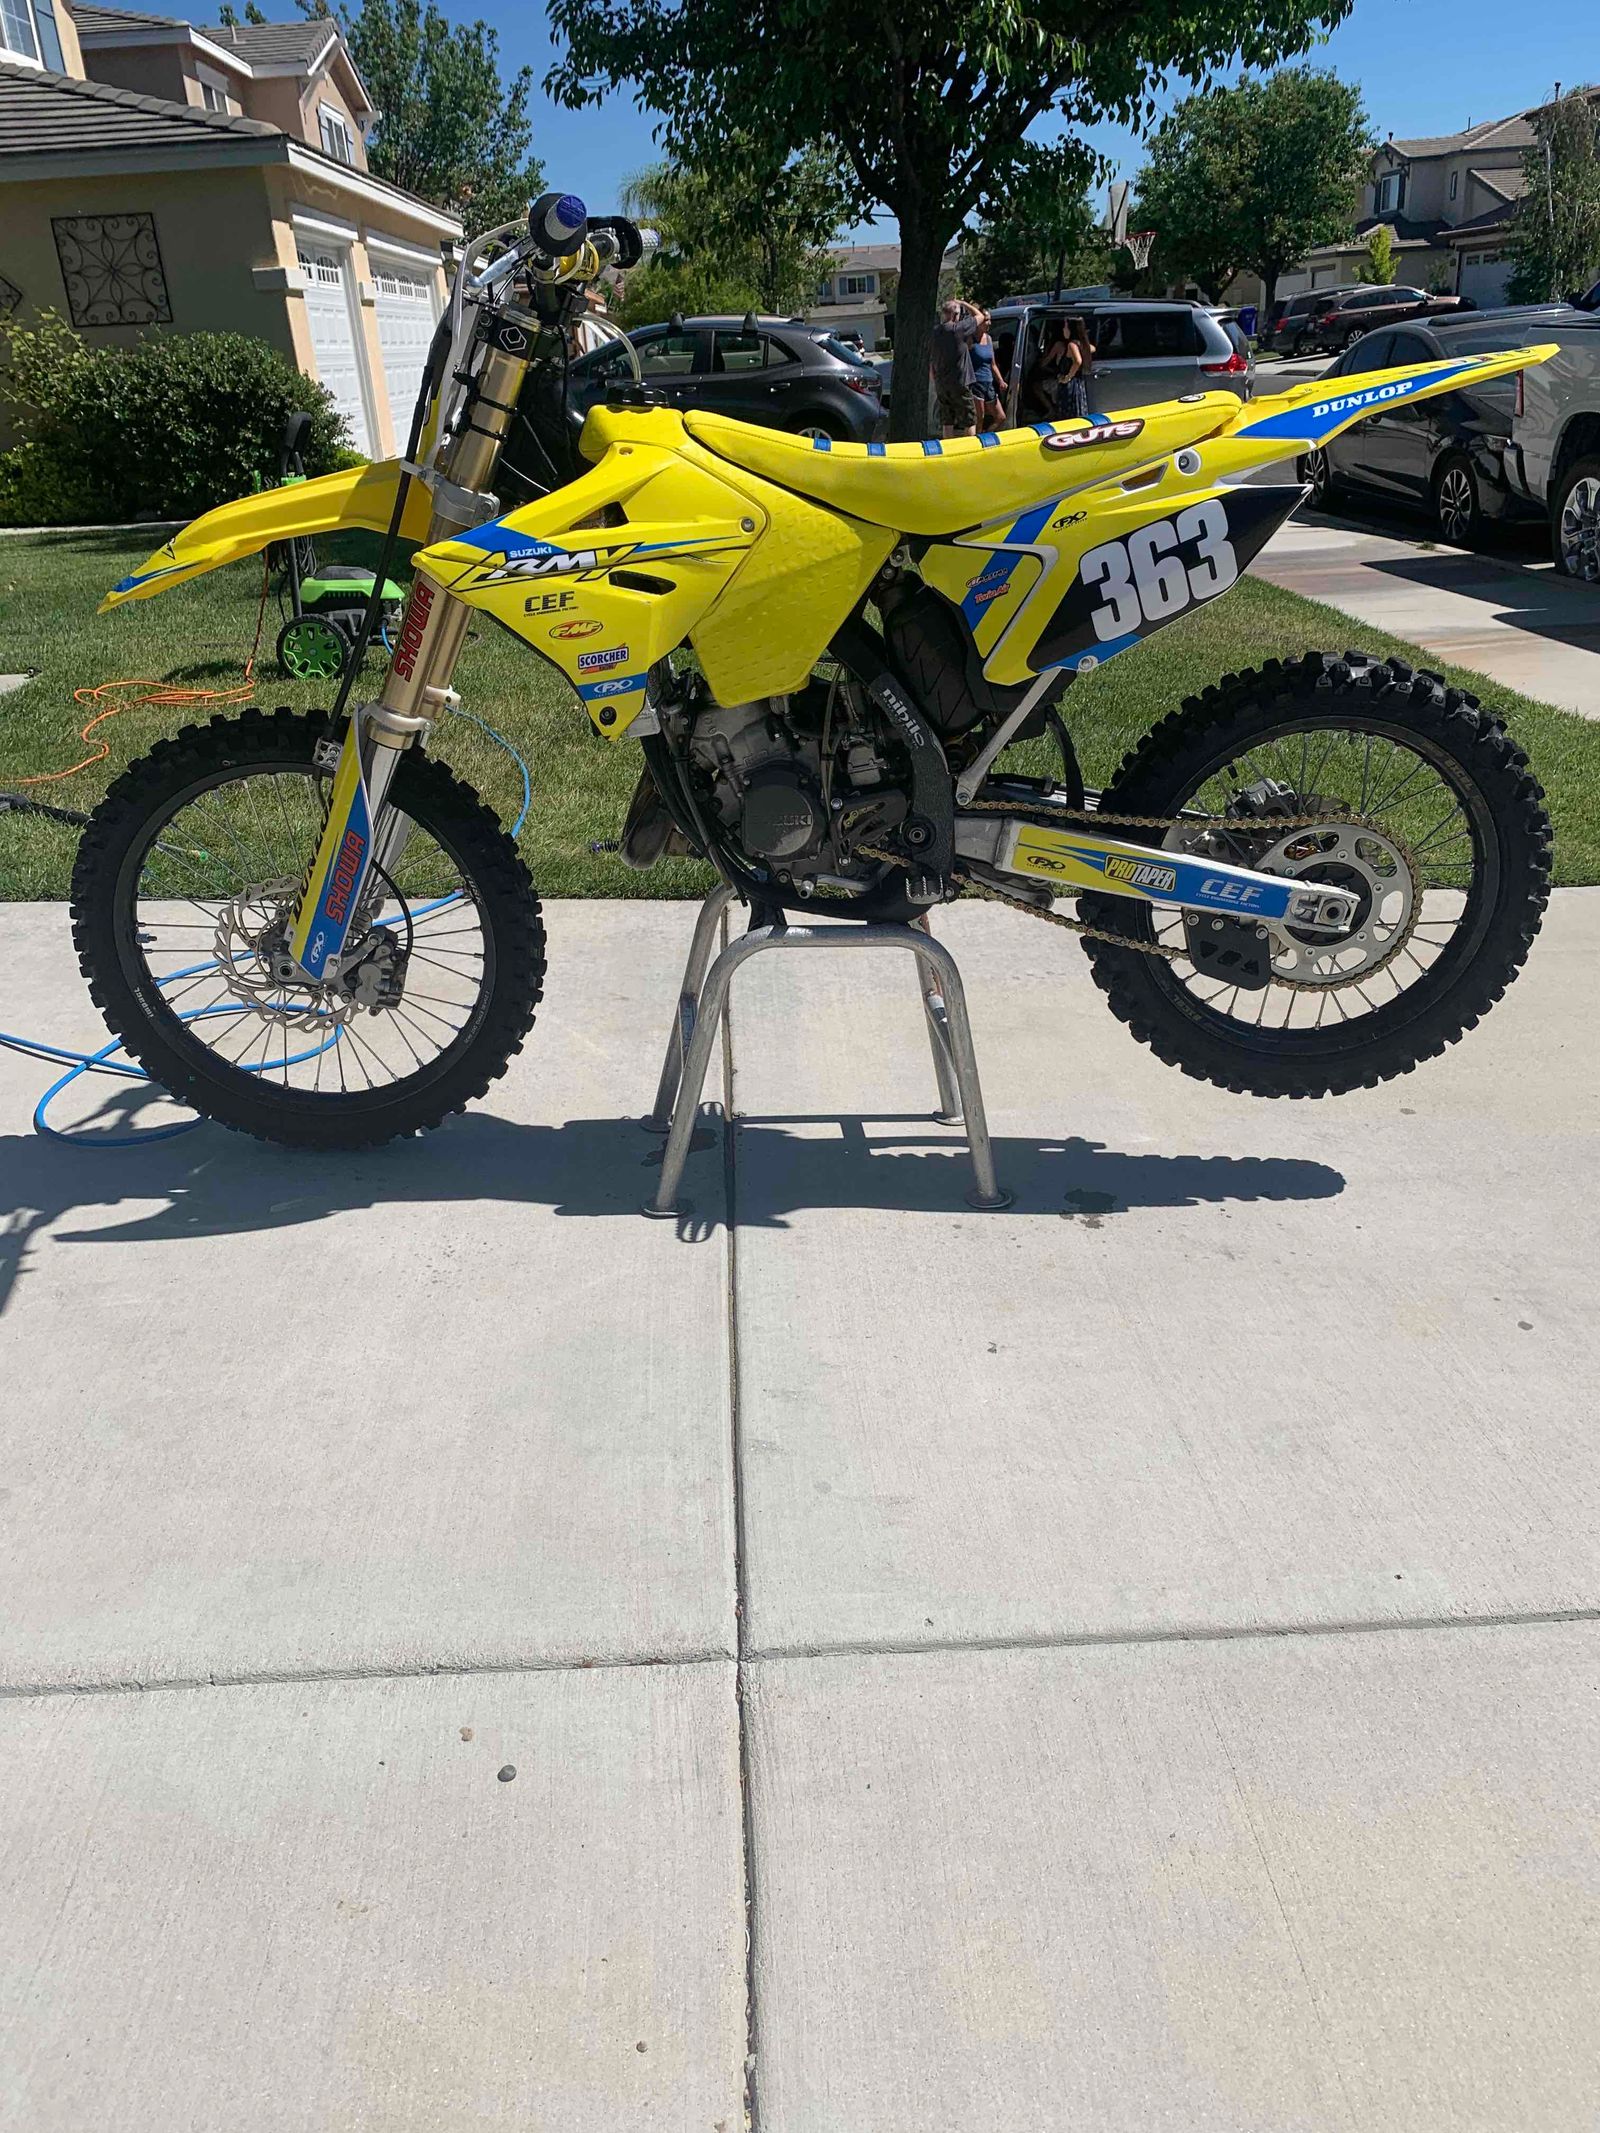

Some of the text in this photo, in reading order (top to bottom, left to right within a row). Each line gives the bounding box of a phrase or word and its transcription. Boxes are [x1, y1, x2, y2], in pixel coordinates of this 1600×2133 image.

[1312, 381, 1413, 418] DUNLOP
[1048, 419, 1140, 447] GUTS
[509, 546, 553, 558] SUZUKI
[1080, 499, 1239, 642] 363
[524, 591, 575, 613] CEF
[394, 581, 435, 683] SHOWA
[550, 620, 603, 640] FMF
[580, 650, 627, 667] SCORCHER
[883, 688, 925, 747] nihilo
[325, 828, 366, 925] SHOWA
[1107, 858, 1174, 890] PROTAPER
[1200, 878, 1264, 902] CEF
[134, 986, 154, 1018] impact
